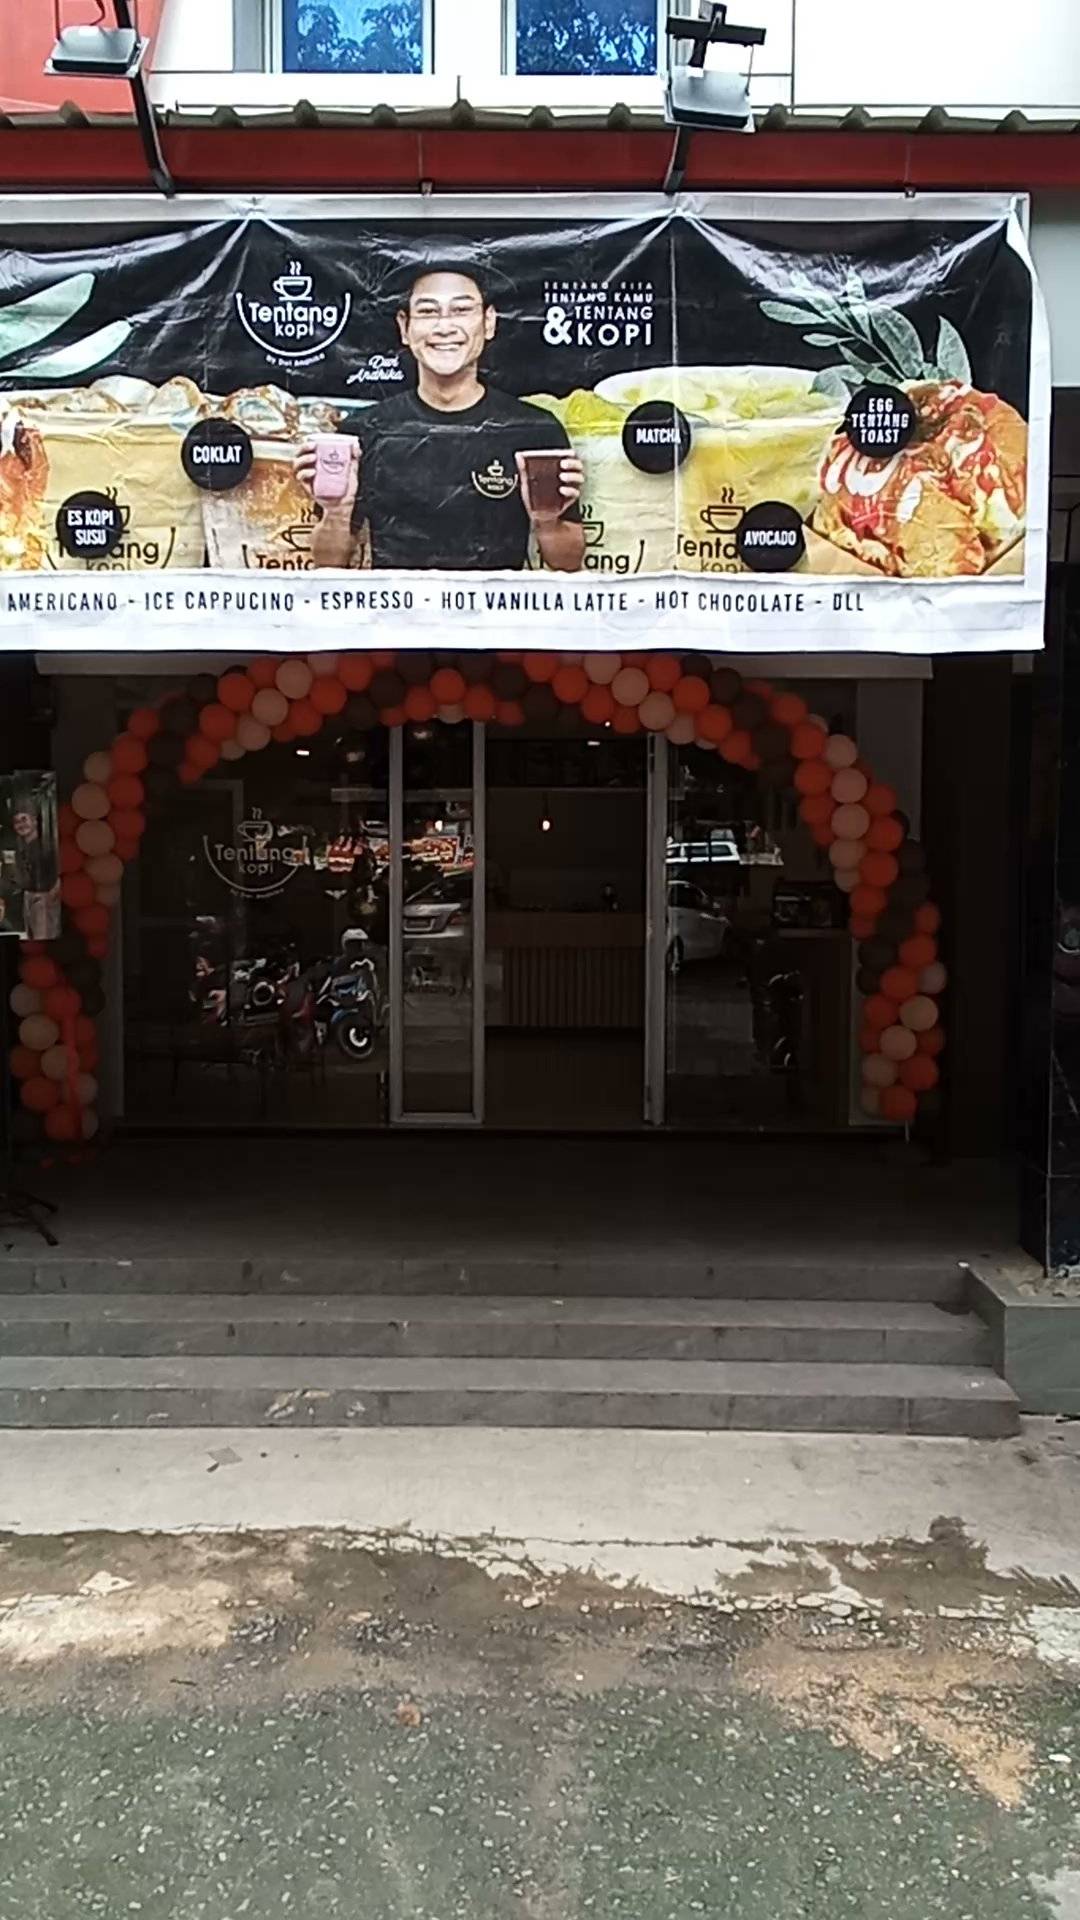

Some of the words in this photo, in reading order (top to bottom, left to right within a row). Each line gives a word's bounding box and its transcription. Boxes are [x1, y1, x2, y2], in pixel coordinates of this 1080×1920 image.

[544, 292, 608, 303] TENTANG
[614, 292, 653, 303] KAMU
[249, 302, 338, 328] Tentang
[275, 321, 315, 340] kopi
[543, 306, 573, 345] &
[574, 305, 653, 320] TENTANG
[577, 323, 652, 346] KOPI
[868, 397, 893, 412] EGG
[851, 412, 909, 429] TENTANG
[636, 428, 682, 444] MATCHA
[860, 429, 899, 444] TOAST
[192, 445, 242, 464] COKLAT
[67, 510, 83, 526] ES
[85, 510, 114, 526] KOPI
[75, 529, 106, 546] SUSU
[744, 530, 797, 546] AVOCADO
[8, 592, 118, 612] AMERICANO
[145, 592, 175, 610] ICE
[185, 592, 294, 611] CAPPUCINO
[321, 591, 414, 611] ESPRESSO
[442, 592, 477, 610] HOT
[485, 592, 564, 611] VANILLA
[574, 593, 628, 611] LATTE
[655, 591, 689, 610] HOT
[698, 593, 805, 612] CHOCOLATE
[833, 593, 865, 611] DLL
